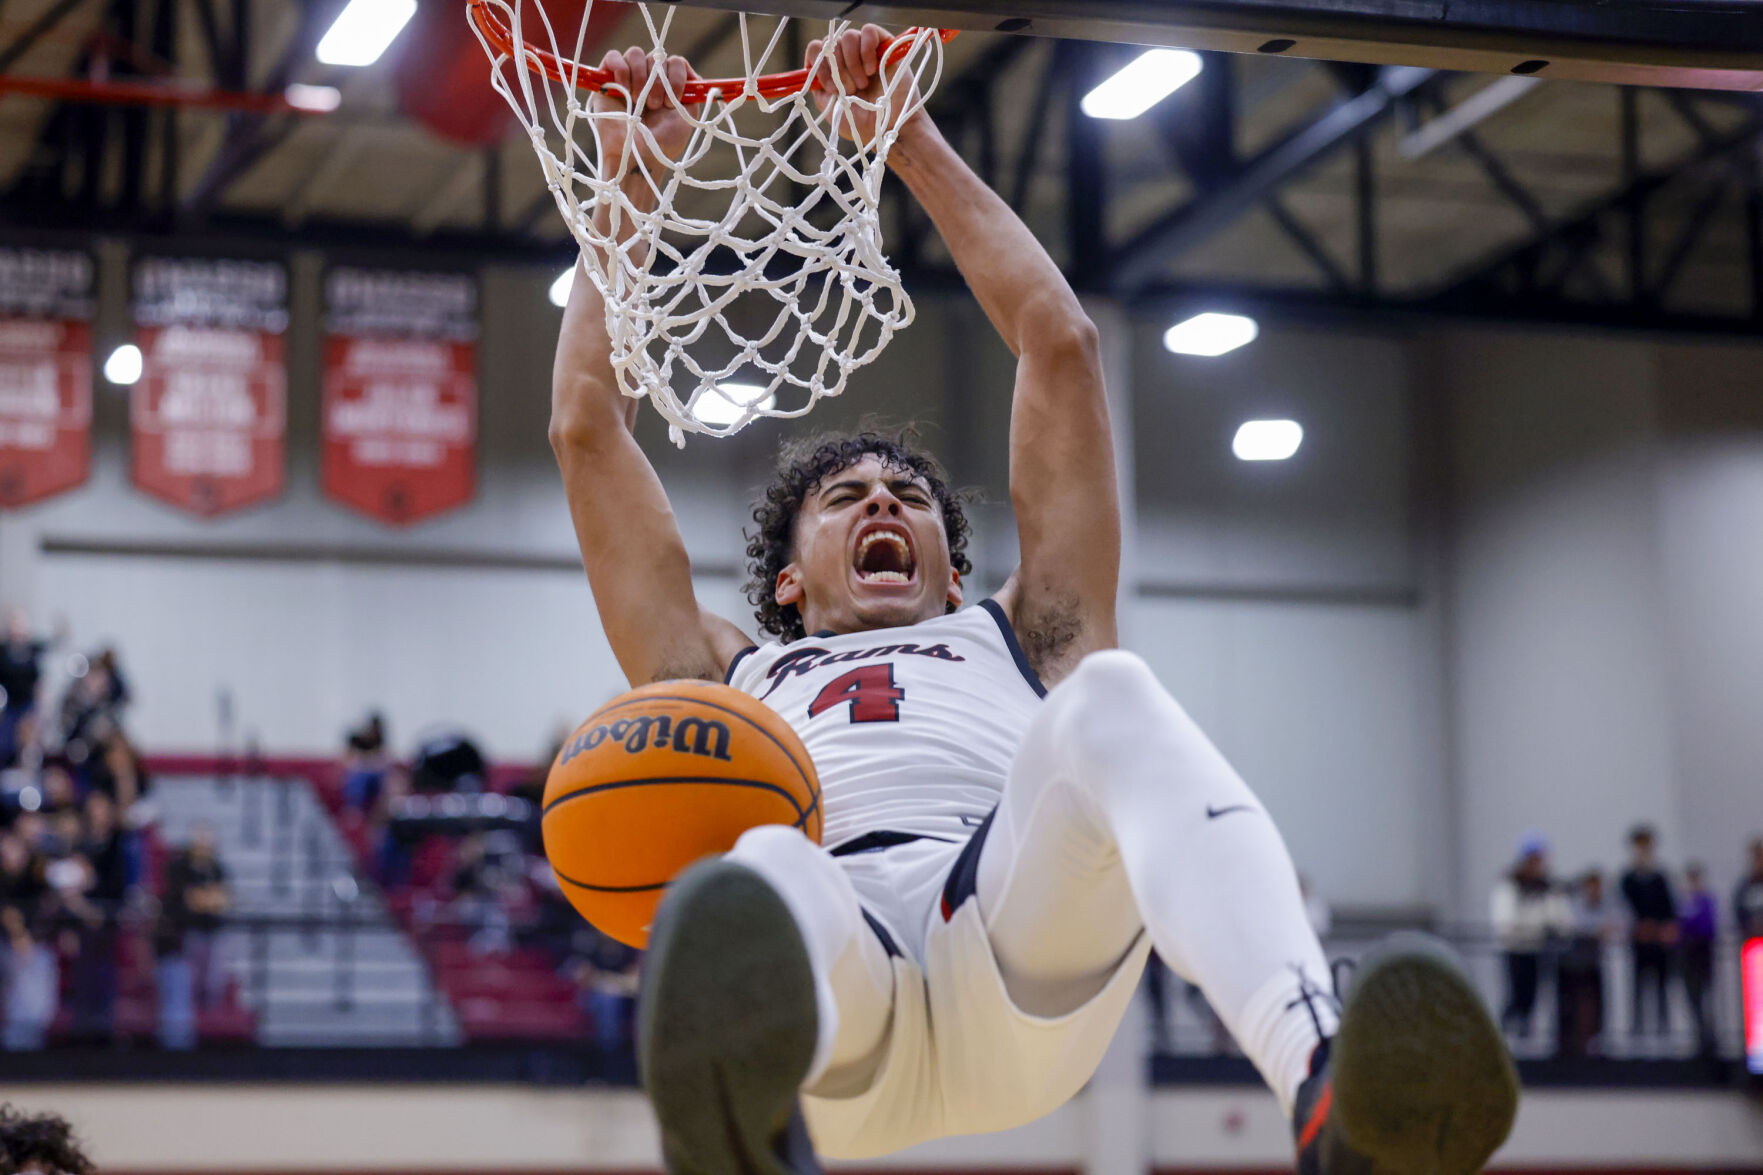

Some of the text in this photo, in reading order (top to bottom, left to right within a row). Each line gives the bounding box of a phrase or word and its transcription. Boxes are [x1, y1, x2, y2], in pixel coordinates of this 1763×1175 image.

[758, 644, 966, 701] Rams
[807, 662, 905, 724] 4
[561, 714, 733, 766] Wilson
